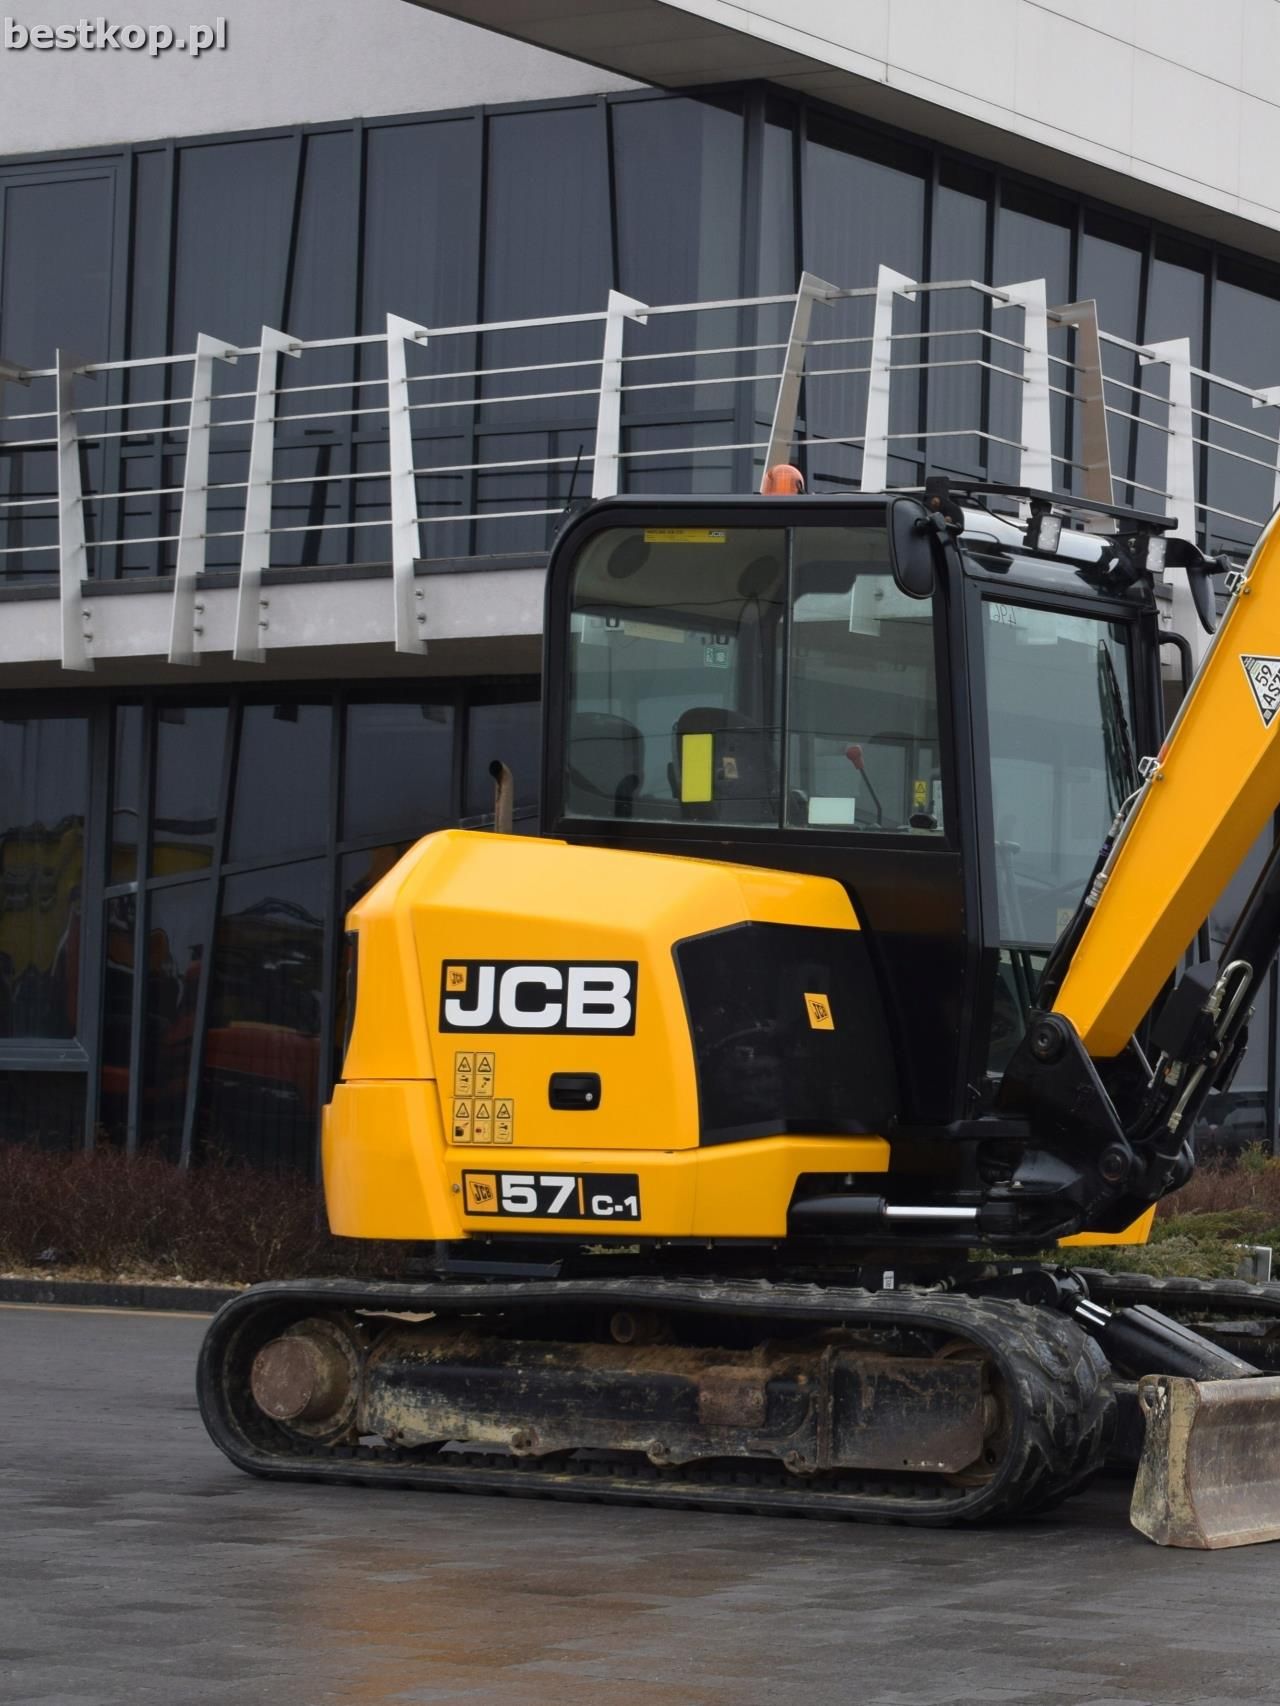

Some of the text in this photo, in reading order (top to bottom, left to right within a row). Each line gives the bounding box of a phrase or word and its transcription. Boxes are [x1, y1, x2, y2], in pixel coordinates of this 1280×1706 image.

[1255, 664, 1273, 687] 59
[445, 966, 631, 1028] JCB
[473, 1181, 493, 1202] JCB
[501, 1174, 638, 1217] 57 C-1
